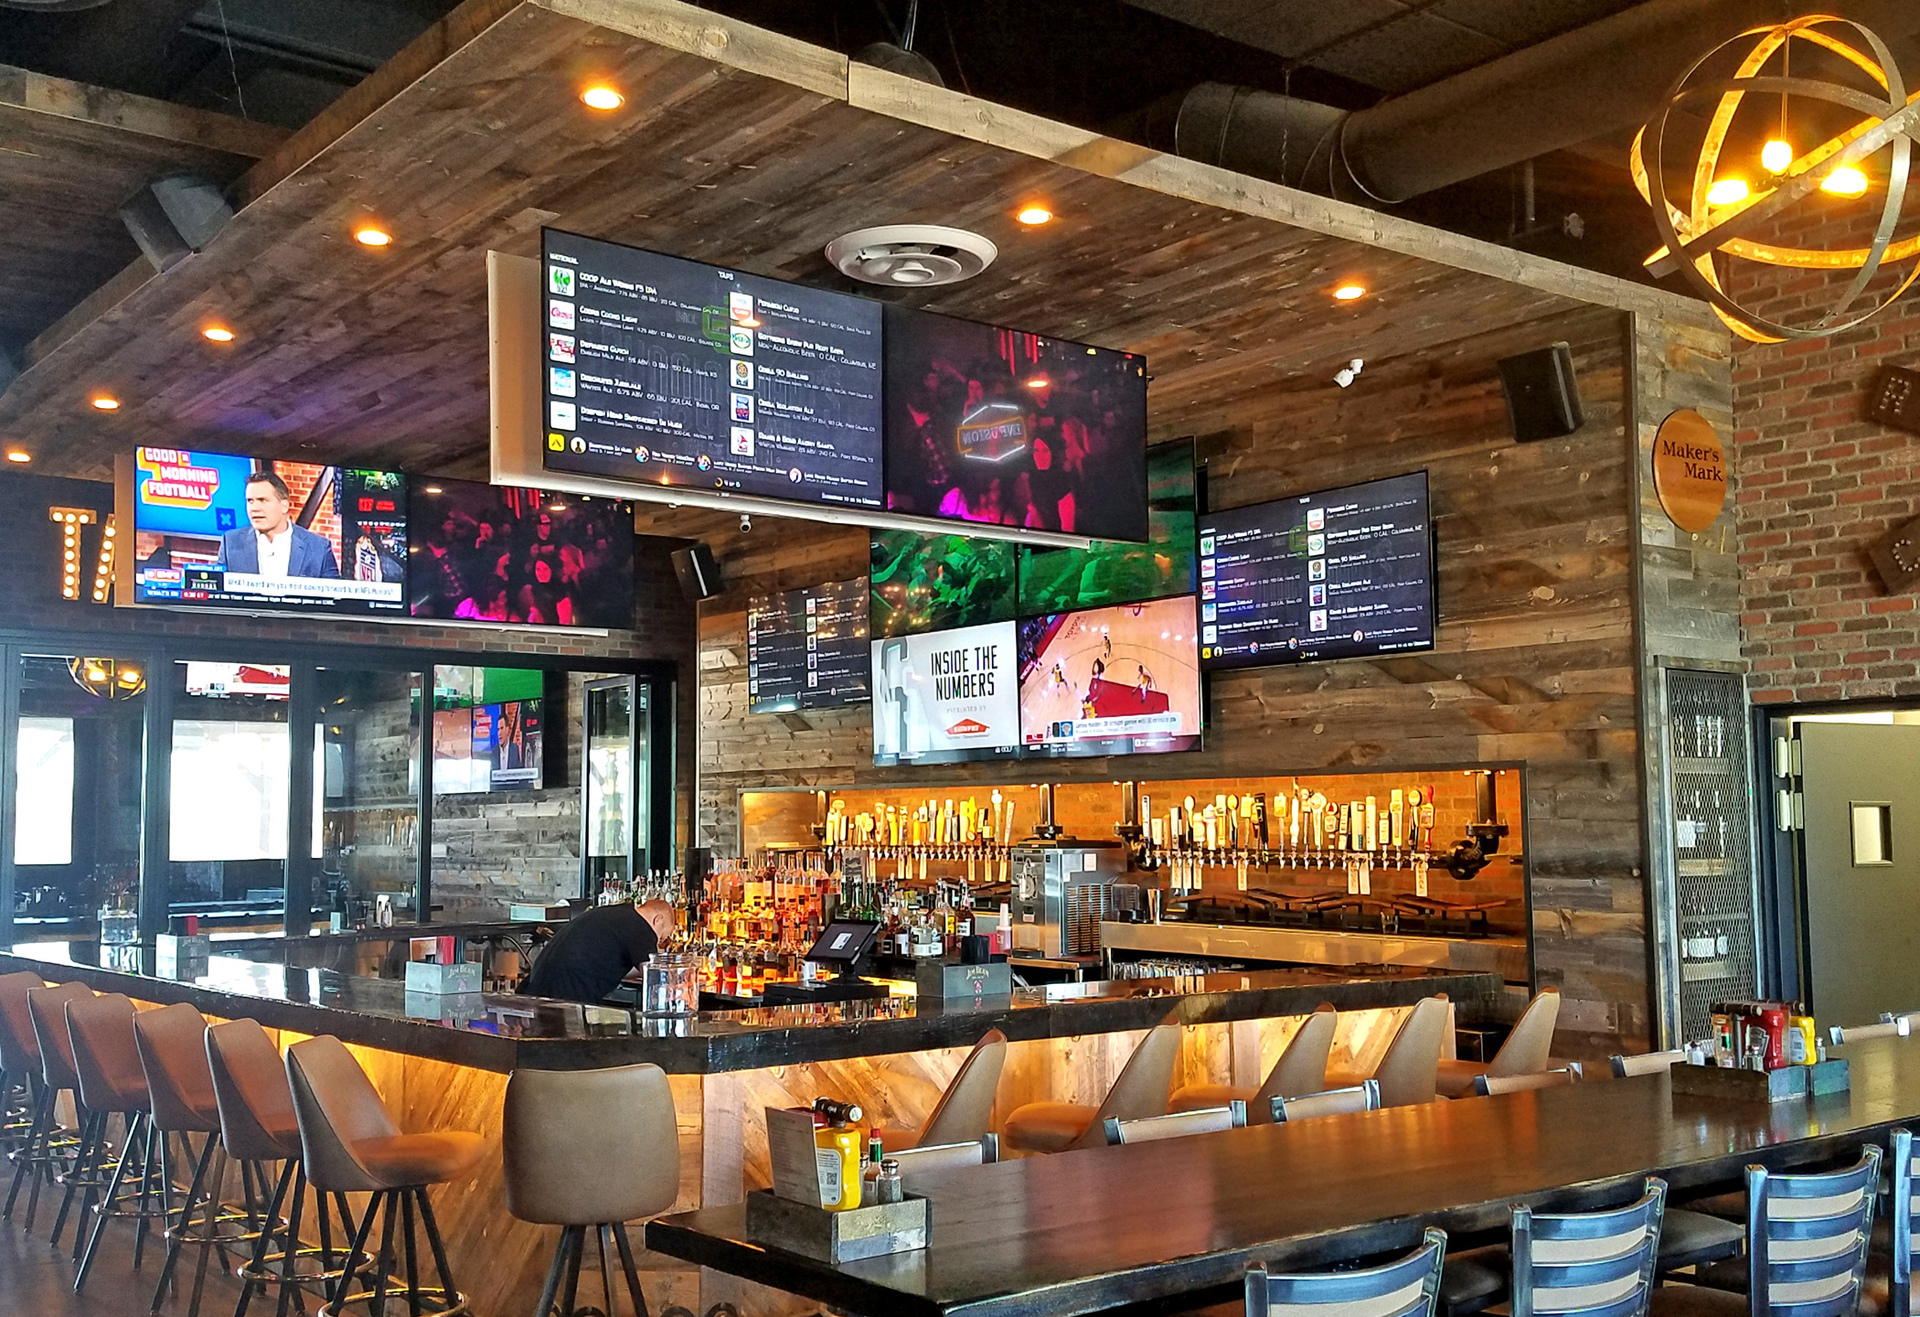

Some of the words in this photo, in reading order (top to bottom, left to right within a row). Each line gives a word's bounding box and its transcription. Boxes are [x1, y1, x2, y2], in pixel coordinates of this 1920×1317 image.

[144, 447, 178, 463] GOOD
[1663, 440, 1720, 462] Maker's
[160, 465, 218, 484] MORNING
[1684, 462, 1724, 482] Mark
[149, 483, 209, 500] FOOTBALL
[930, 649, 969, 676] INSIDE
[974, 645, 998, 670] THE
[935, 672, 995, 701] NUMBERS
[976, 966, 990, 977] BEAM
